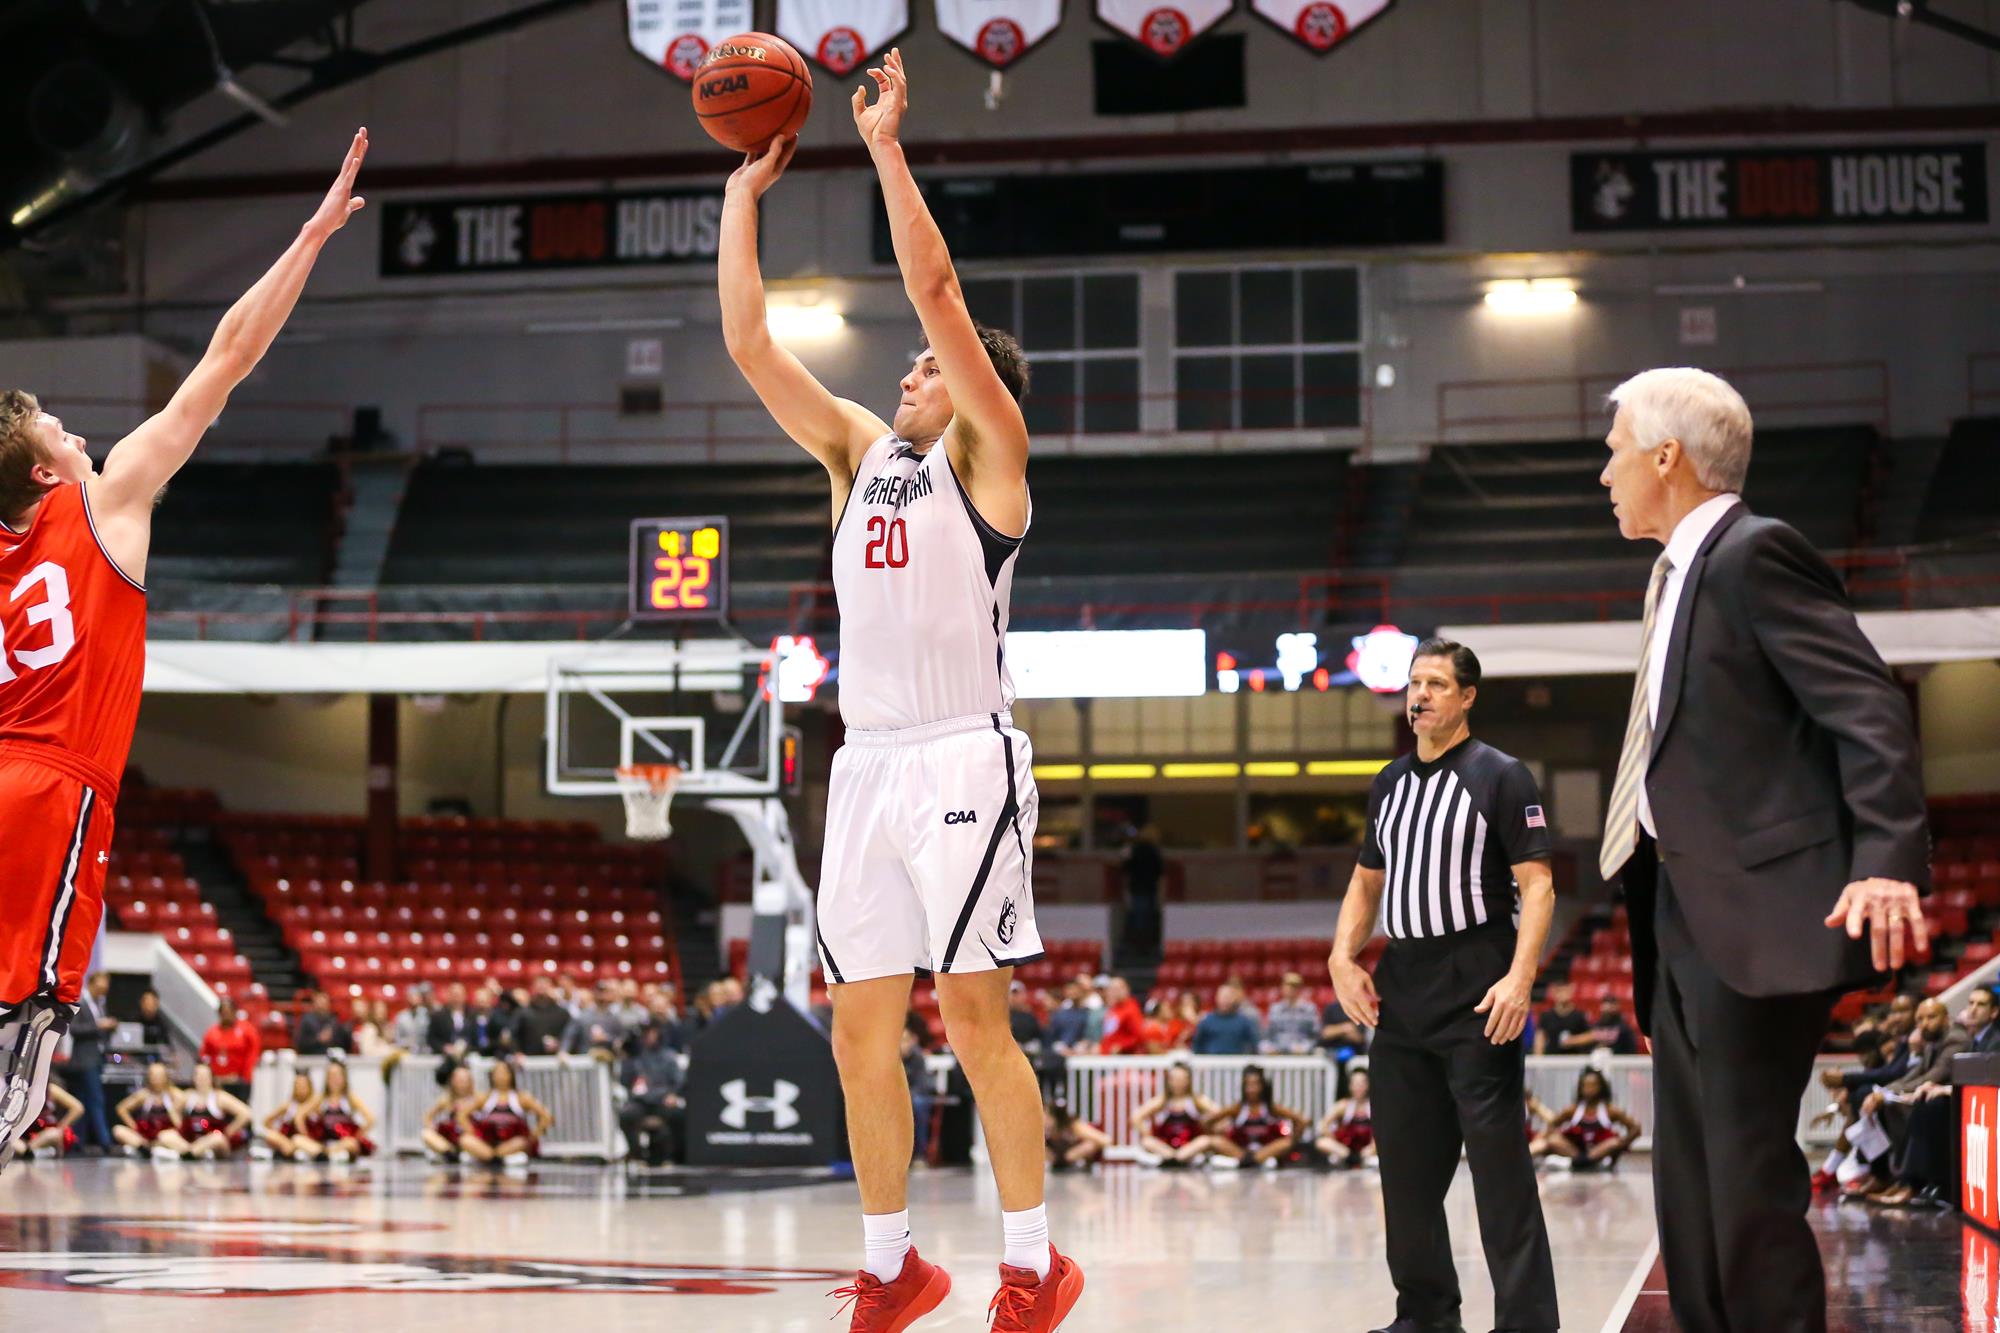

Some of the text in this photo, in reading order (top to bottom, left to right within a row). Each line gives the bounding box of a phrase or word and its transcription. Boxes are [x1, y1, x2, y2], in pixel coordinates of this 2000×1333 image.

[700, 74, 749, 100] NCAA
[1653, 155, 1963, 219] THE DOG HOUSE
[453, 198, 720, 264] THE DOG HOUS
[865, 516, 909, 569] 20
[651, 557, 710, 610] 22
[0, 561, 76, 684] 3
[944, 810, 977, 825] CAA
